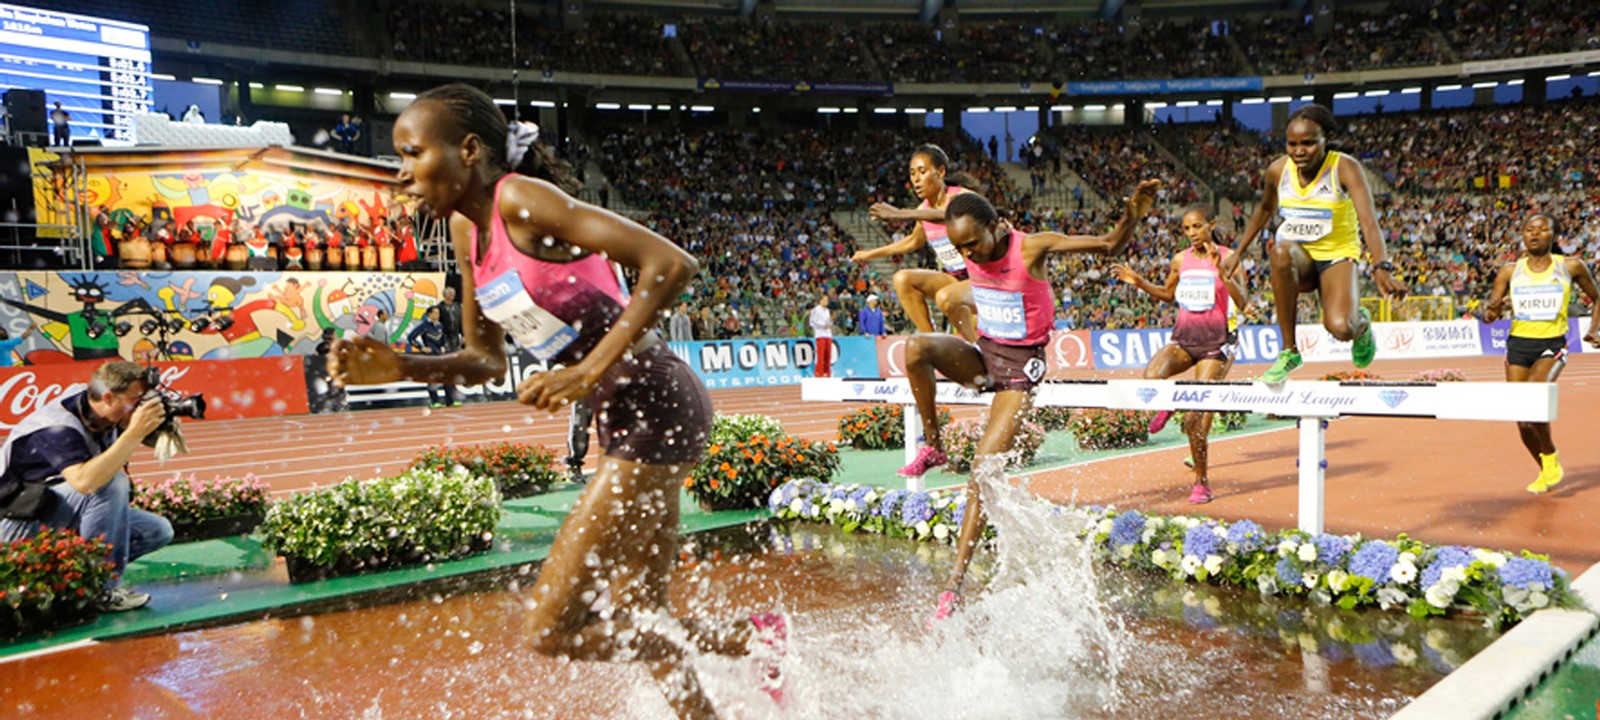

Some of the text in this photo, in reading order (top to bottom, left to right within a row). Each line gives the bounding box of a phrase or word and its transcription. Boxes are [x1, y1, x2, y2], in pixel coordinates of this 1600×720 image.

[1519, 298, 1556, 309] KIRUI
[1029, 361, 1040, 379] 8
[1172, 390, 1359, 409] IAAF Diamond League
